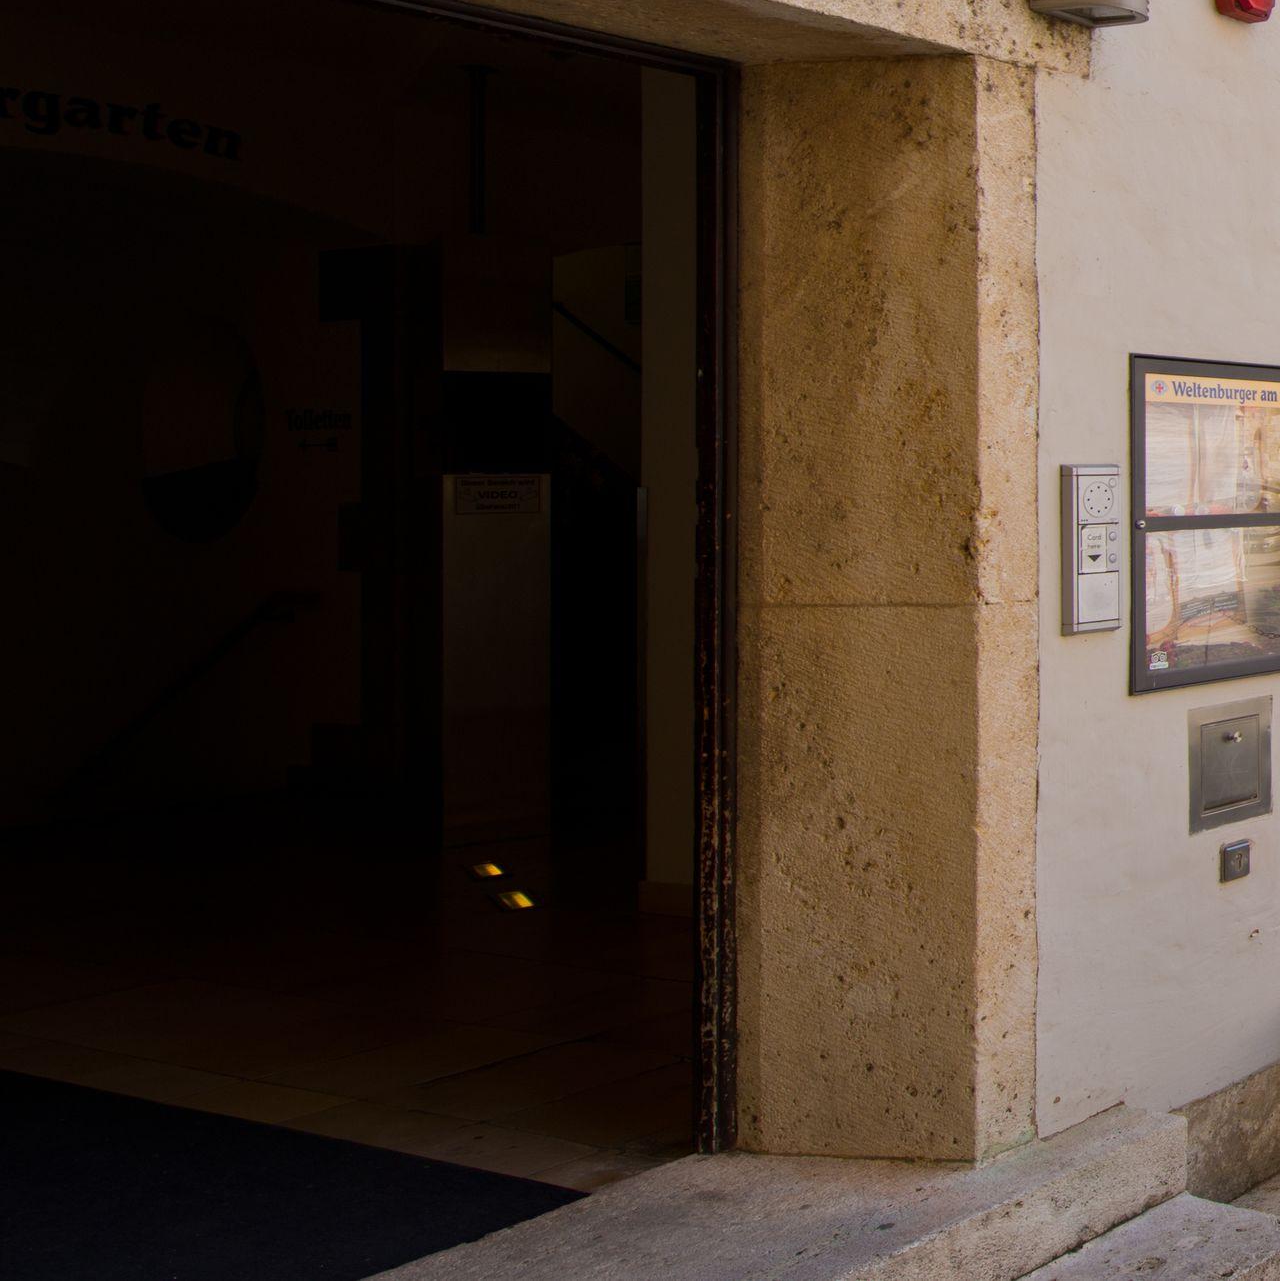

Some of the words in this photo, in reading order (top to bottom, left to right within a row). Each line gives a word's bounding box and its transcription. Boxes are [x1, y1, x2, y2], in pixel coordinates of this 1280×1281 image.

[1171, 380, 1257, 404] Weltenburger
[1260, 388, 1278, 402] am
[477, 490, 519, 500] VIDEO
